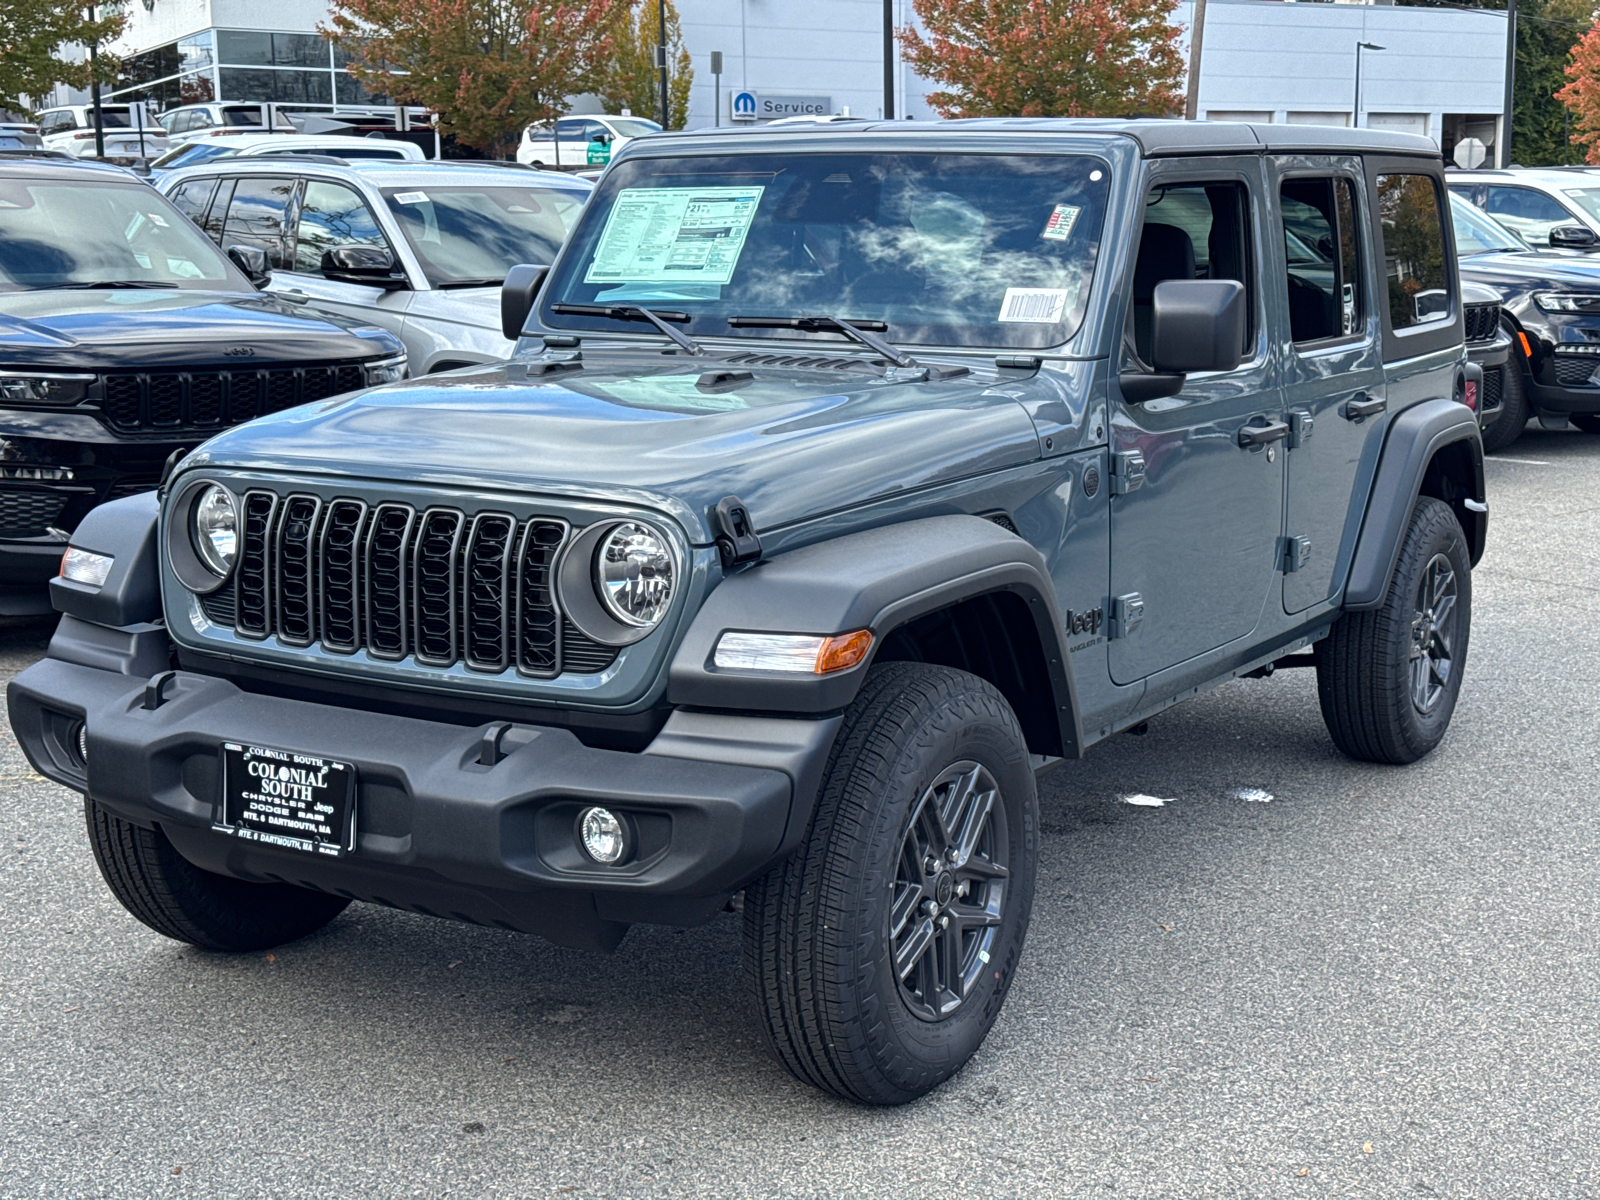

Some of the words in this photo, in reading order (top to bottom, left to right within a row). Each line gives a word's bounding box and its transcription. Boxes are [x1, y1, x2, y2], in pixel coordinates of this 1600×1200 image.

[763, 100, 824, 114] Service
[690, 204, 701, 212] 21
[222, 346, 255, 357] Jeep
[1065, 606, 1104, 637] Jeep
[249, 747, 290, 761] COLONIAL
[293, 755, 324, 767] SOUTH
[248, 761, 328, 788] COLONIAL
[261, 778, 313, 801] SOUTH
[241, 791, 306, 809] CHRYSLER
[314, 802, 334, 815] Jeep
[250, 802, 290, 816] DODGE
[298, 811, 325, 822] RAM
[243, 811, 259, 821] RTE.
[260, 814, 266, 822] 6
[268, 815, 318, 833] DARTMOUTH,
[318, 825, 331, 834] MA
[238, 829, 253, 840] RTE.
[260, 833, 302, 850] DARTMOUTH,
[302, 842, 313, 851] MA
